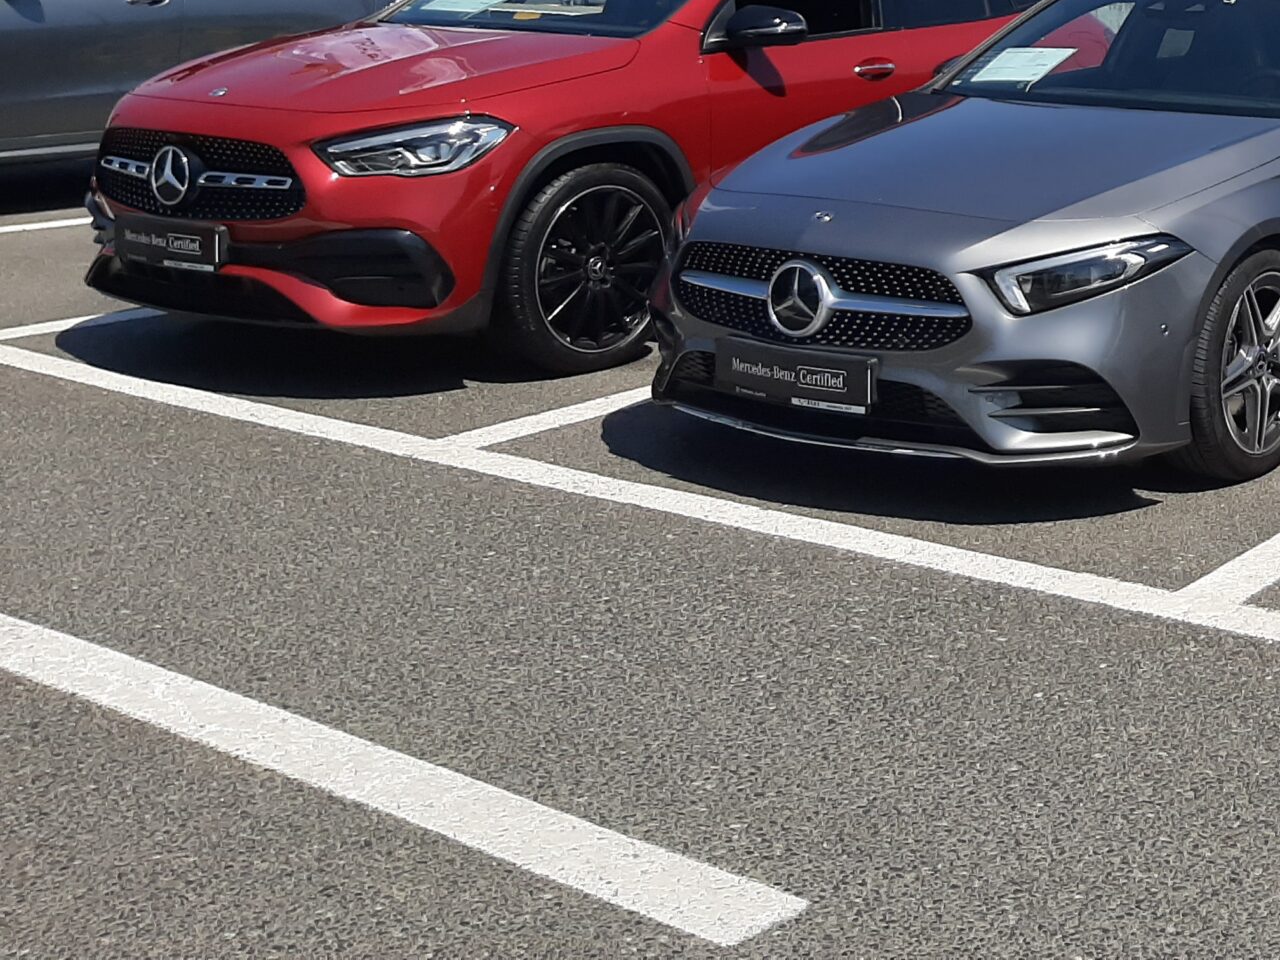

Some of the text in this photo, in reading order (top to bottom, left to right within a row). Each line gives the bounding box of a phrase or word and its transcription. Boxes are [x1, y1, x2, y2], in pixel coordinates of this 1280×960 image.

[168, 237, 200, 252] Certified
[731, 356, 844, 389] Mercedes-Benz Certified
